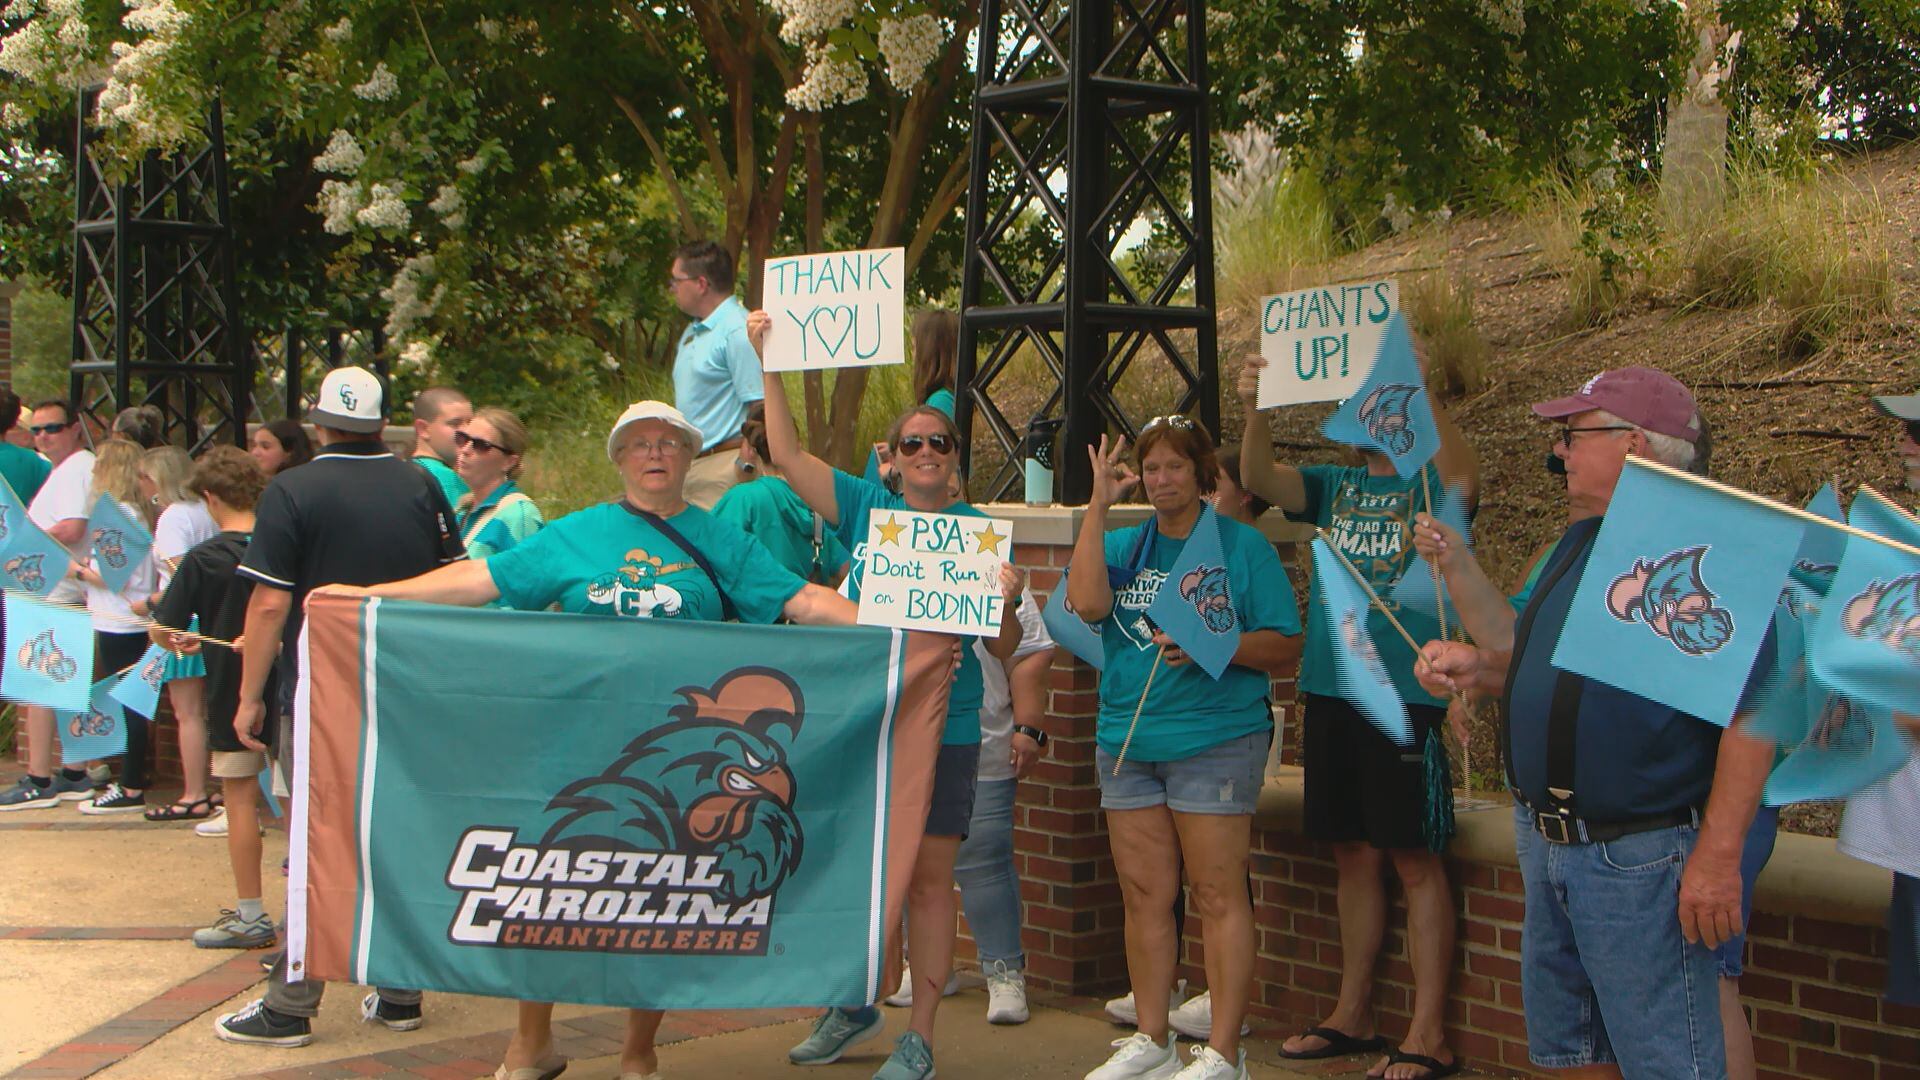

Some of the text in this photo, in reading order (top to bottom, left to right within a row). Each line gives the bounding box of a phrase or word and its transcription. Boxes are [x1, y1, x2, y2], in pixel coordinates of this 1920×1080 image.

[769, 252, 892, 295] THANK
[1264, 282, 1390, 334] CHANTS
[1295, 332, 1349, 380] UP!
[911, 517, 971, 553] PSA:
[1329, 527, 1402, 557] OMAHA
[1331, 514, 1354, 531] THE
[1384, 521, 1402, 533] TO
[871, 553, 981, 585] Don't Run
[874, 588, 1004, 627] on BODINE
[449, 829, 725, 888] COASTAL
[452, 885, 772, 943] CAROLINA
[503, 922, 761, 951] CHANTICLEERS
